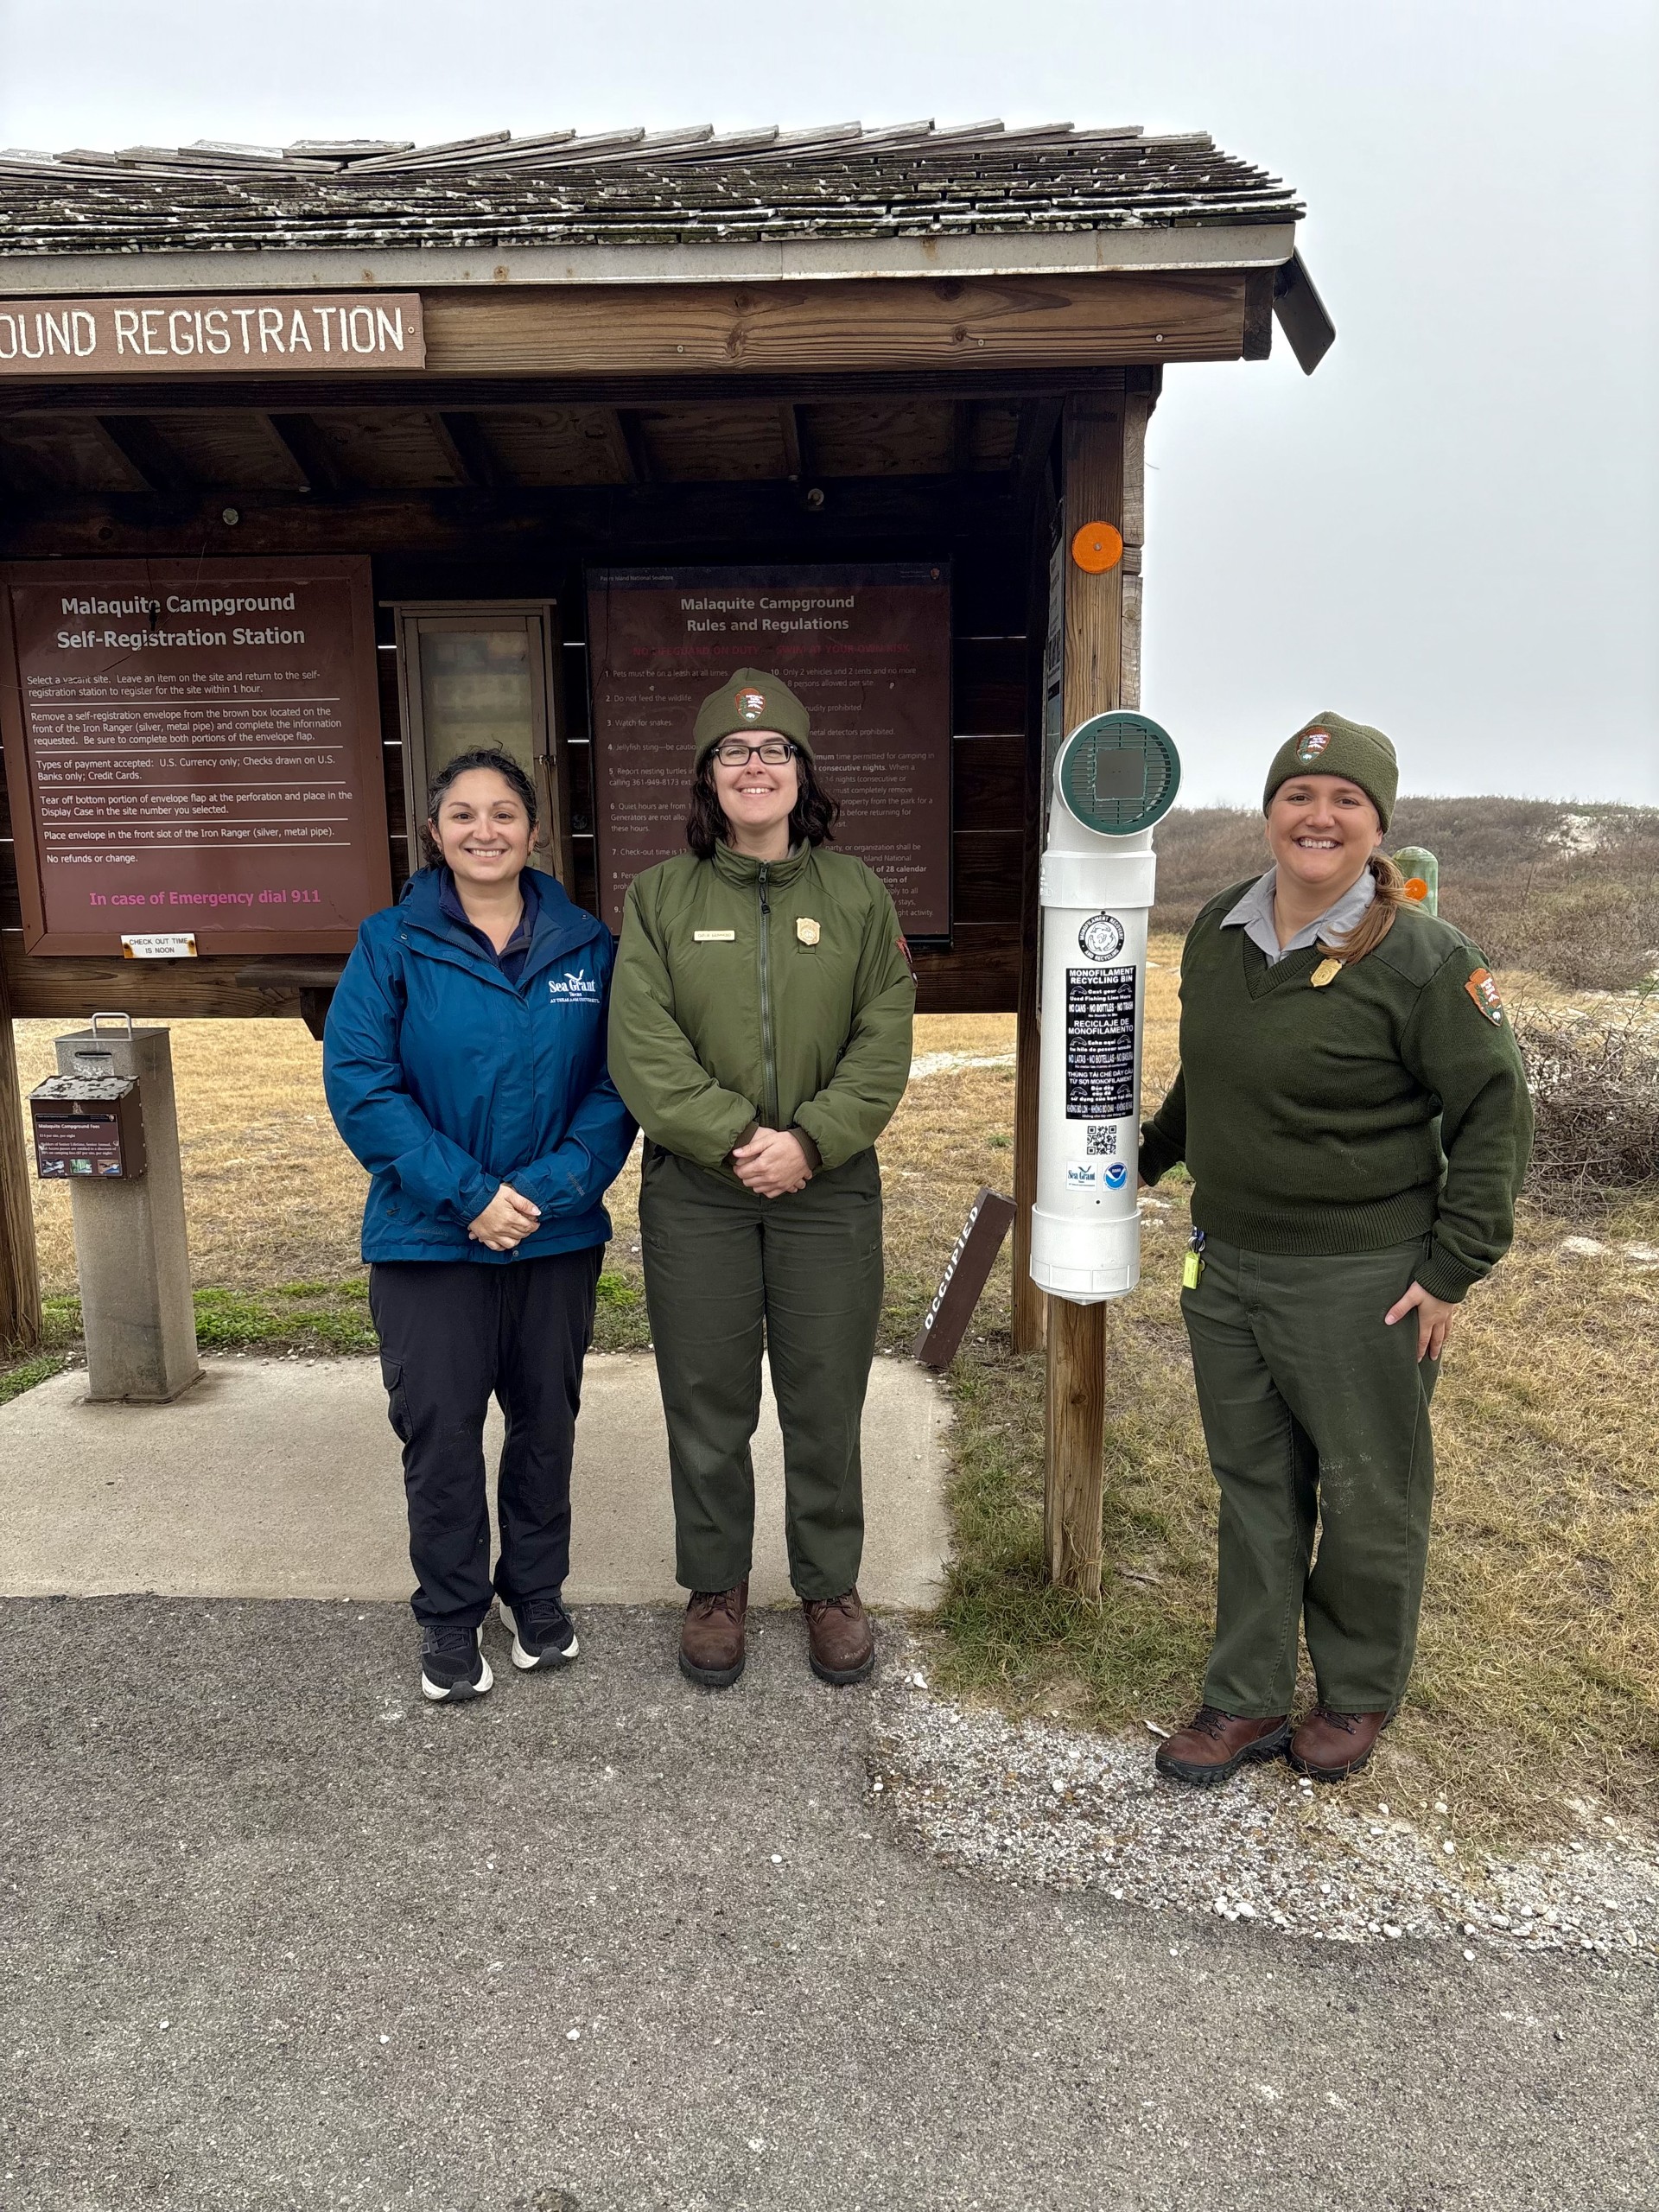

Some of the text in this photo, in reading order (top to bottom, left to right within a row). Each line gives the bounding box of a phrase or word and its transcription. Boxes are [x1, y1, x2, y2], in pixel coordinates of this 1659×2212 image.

[113, 308, 404, 354] REGISTRATION
[61, 593, 295, 617] Malaquite Campground
[681, 595, 854, 612] Malaquite Campground
[687, 618, 849, 632] Rules and Regulations
[57, 626, 304, 650] Self-Registration Station
[27, 676, 53, 684] Select
[92, 675, 111, 683] site.
[117, 675, 142, 683] Leave
[192, 672, 207, 682] the
[208, 672, 224, 682] site
[226, 671, 242, 681] and
[273, 671, 283, 680] to
[285, 671, 299, 680] the
[302, 670, 320, 679] self-
[783, 668, 798, 677] Only
[35, 760, 61, 770] Types
[63, 759, 72, 768] of
[74, 760, 111, 770] payment
[113, 759, 154, 769] accepted:
[159, 758, 176, 767] U.S.
[179, 758, 217, 767] Currency
[219, 757, 239, 767] only;
[243, 756, 273, 766] Checks
[275, 756, 302, 765] drawn
[317, 754, 335, 764] U.S.
[862, 764, 887, 772] nights.
[37, 771, 142, 782] Banks only; Credit Cards.
[608, 779, 630, 787] calling
[900, 797, 915, 805] park
[46, 855, 58, 863] No
[60, 854, 92, 863] refunds
[105, 854, 137, 864] change.
[89, 889, 321, 906] In case of Emergency dial 911
[1079, 916, 1124, 941] MONOFILAMENT RECOVERY
[1084, 949, 1120, 962] AND RECYCLING
[1070, 968, 1134, 977] MONOFILAMENT
[549, 979, 596, 993] Sea Grant
[1069, 1001, 1134, 1013] NO CANS NO BOTTLES NO TRASH
[1069, 1026, 1133, 1034] MONOFILAMENTO
[1096, 1054, 1115, 1063] BOTELLAS
[1068, 1170, 1096, 1180] Sea Grant
[925, 1206, 978, 1330] OCCUPIED
